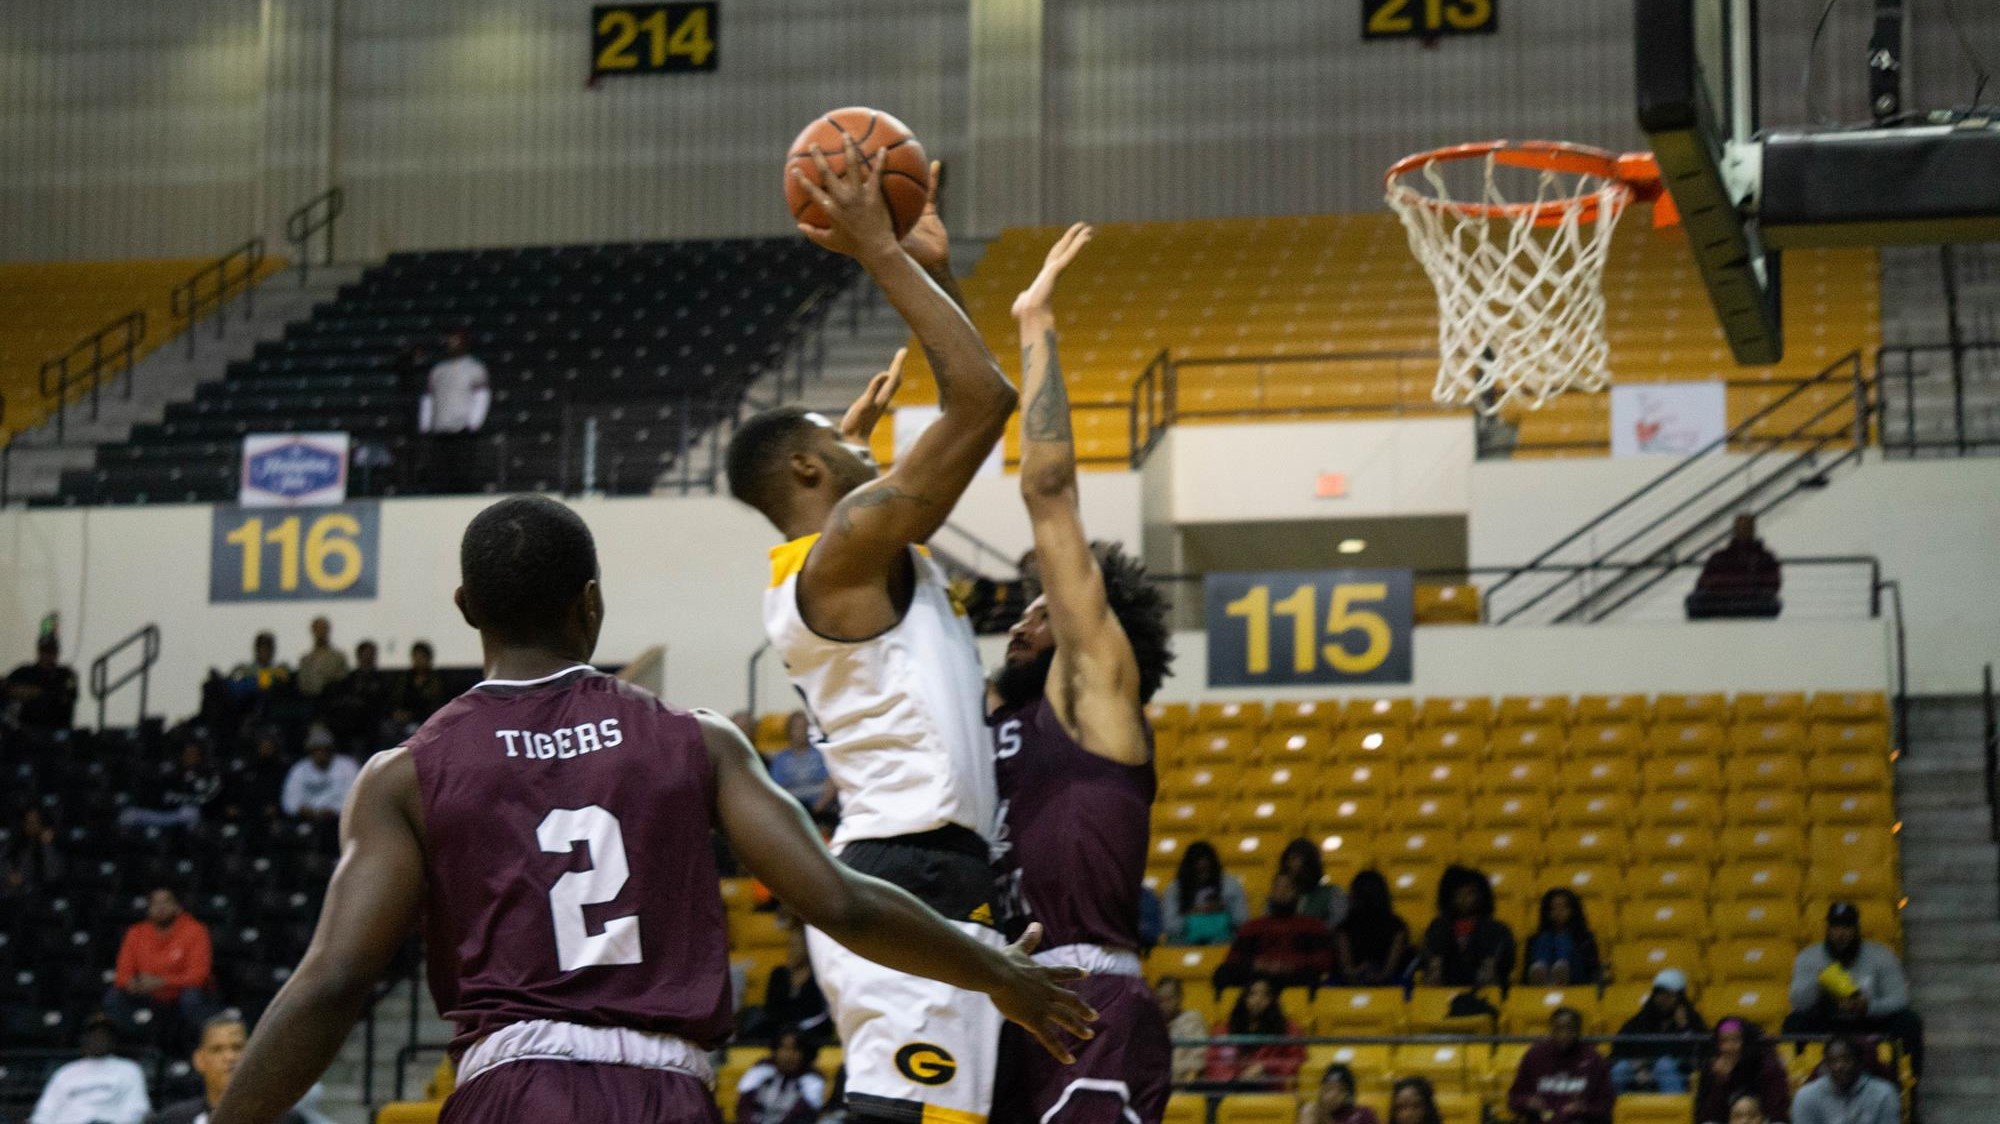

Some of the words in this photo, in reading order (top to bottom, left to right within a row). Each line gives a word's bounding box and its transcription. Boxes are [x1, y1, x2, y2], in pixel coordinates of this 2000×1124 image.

[597, 8, 713, 69] 214
[226, 513, 362, 593] 116
[1225, 582, 1392, 674] 115
[496, 718, 623, 760] TIGERS
[536, 805, 643, 971] 2
[894, 1042, 957, 1086] G
